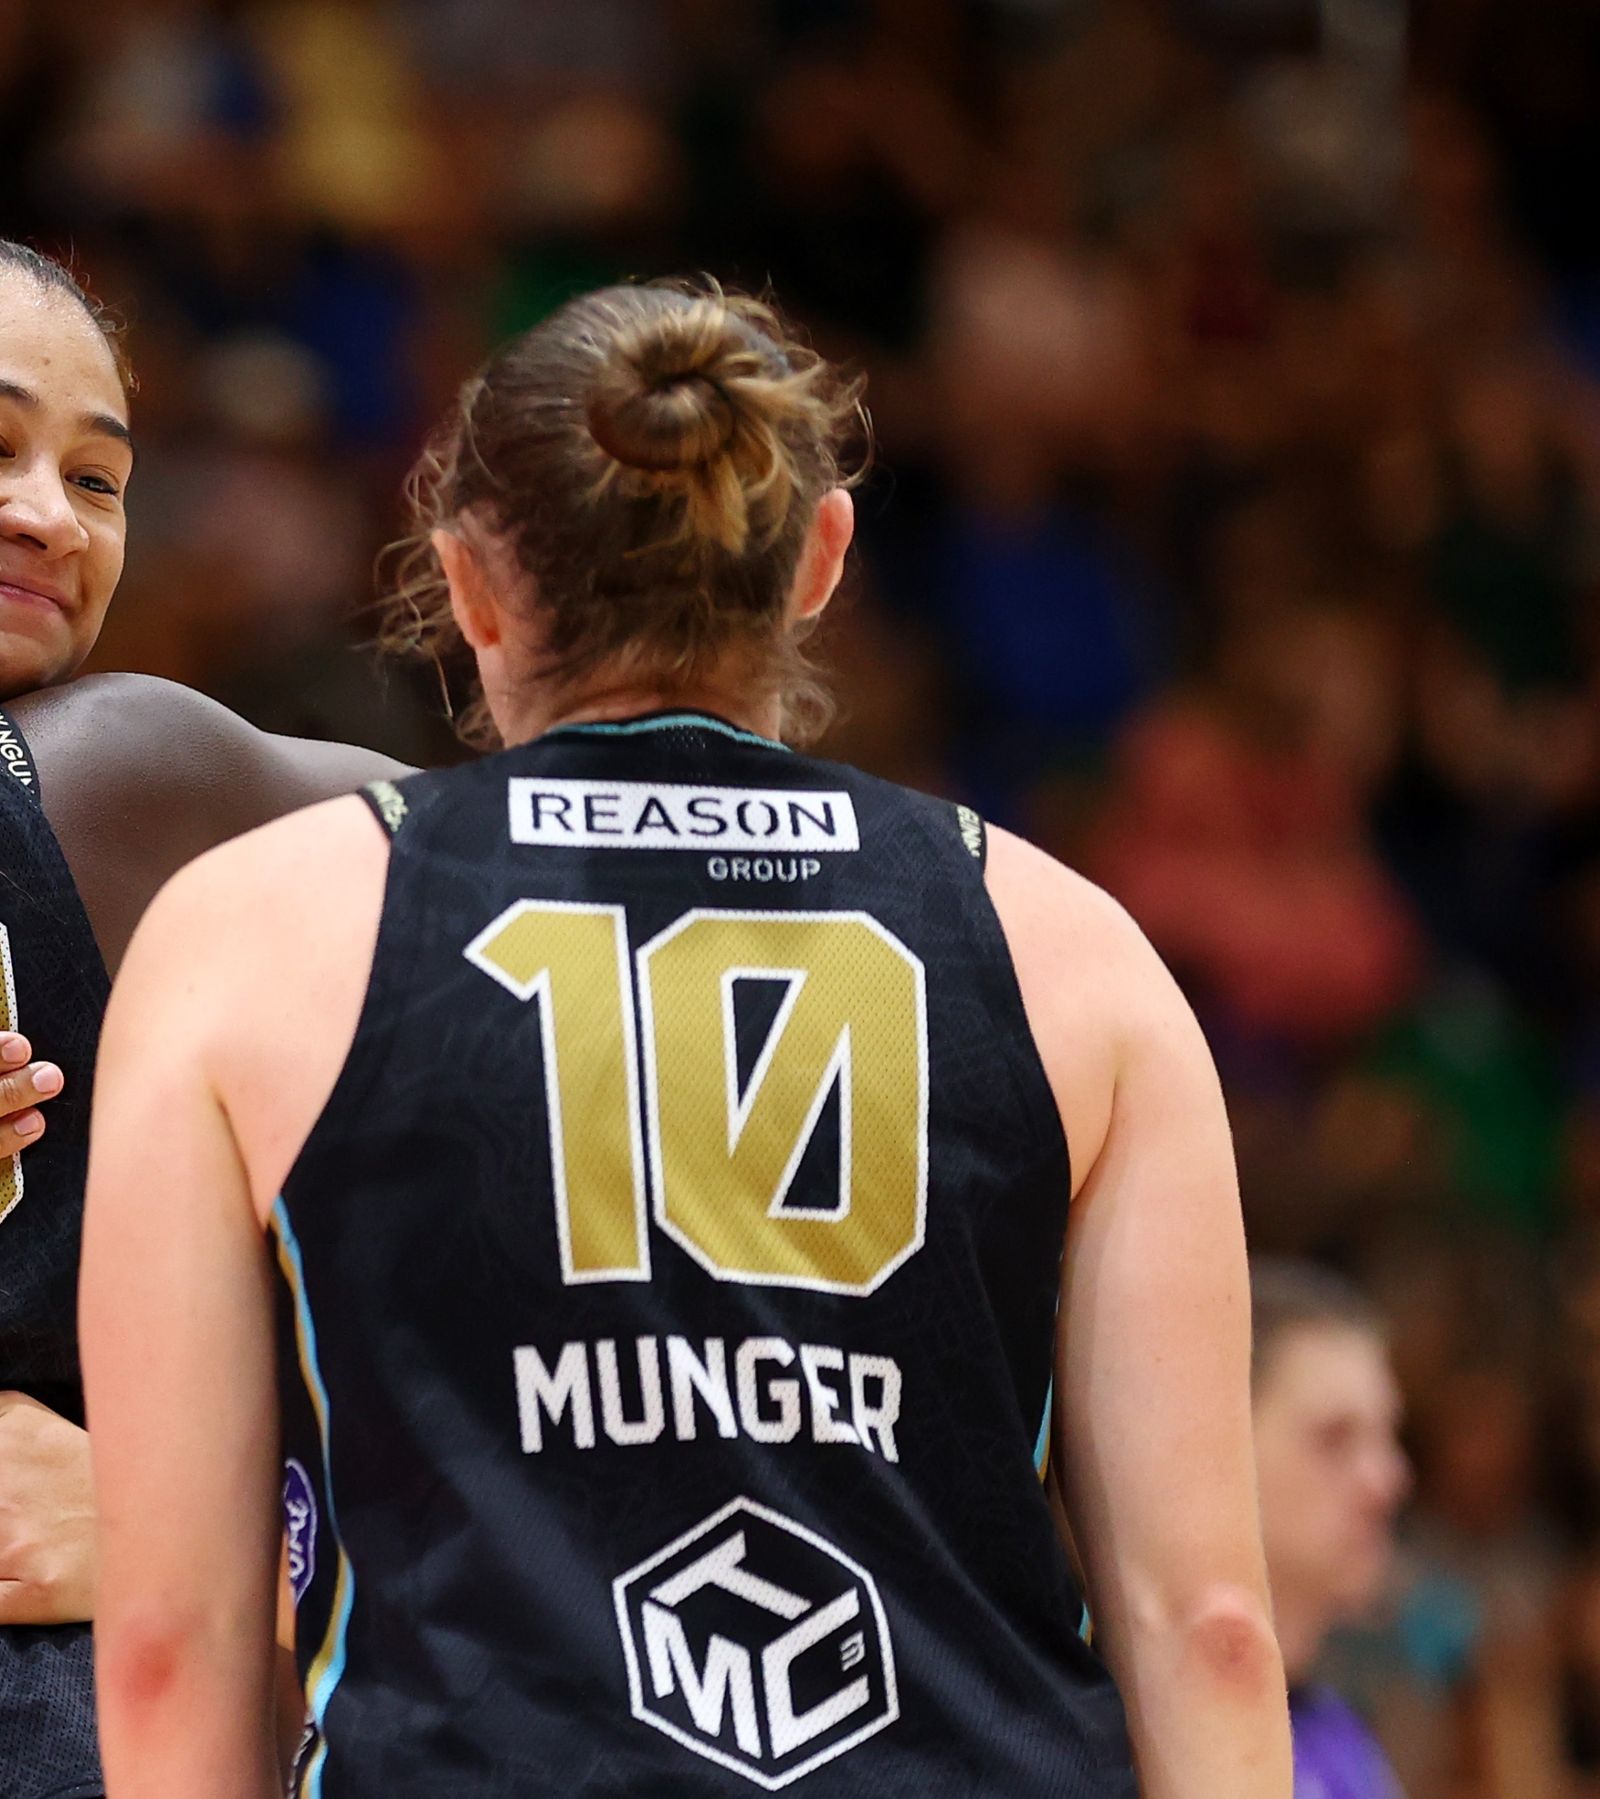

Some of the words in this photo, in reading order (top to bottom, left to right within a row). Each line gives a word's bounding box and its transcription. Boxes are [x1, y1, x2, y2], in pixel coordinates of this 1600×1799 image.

[531, 791, 837, 837] REASON
[706, 856, 822, 883] GROUP
[463, 898, 930, 1298] 10
[512, 1334, 902, 1463] MUNGER
